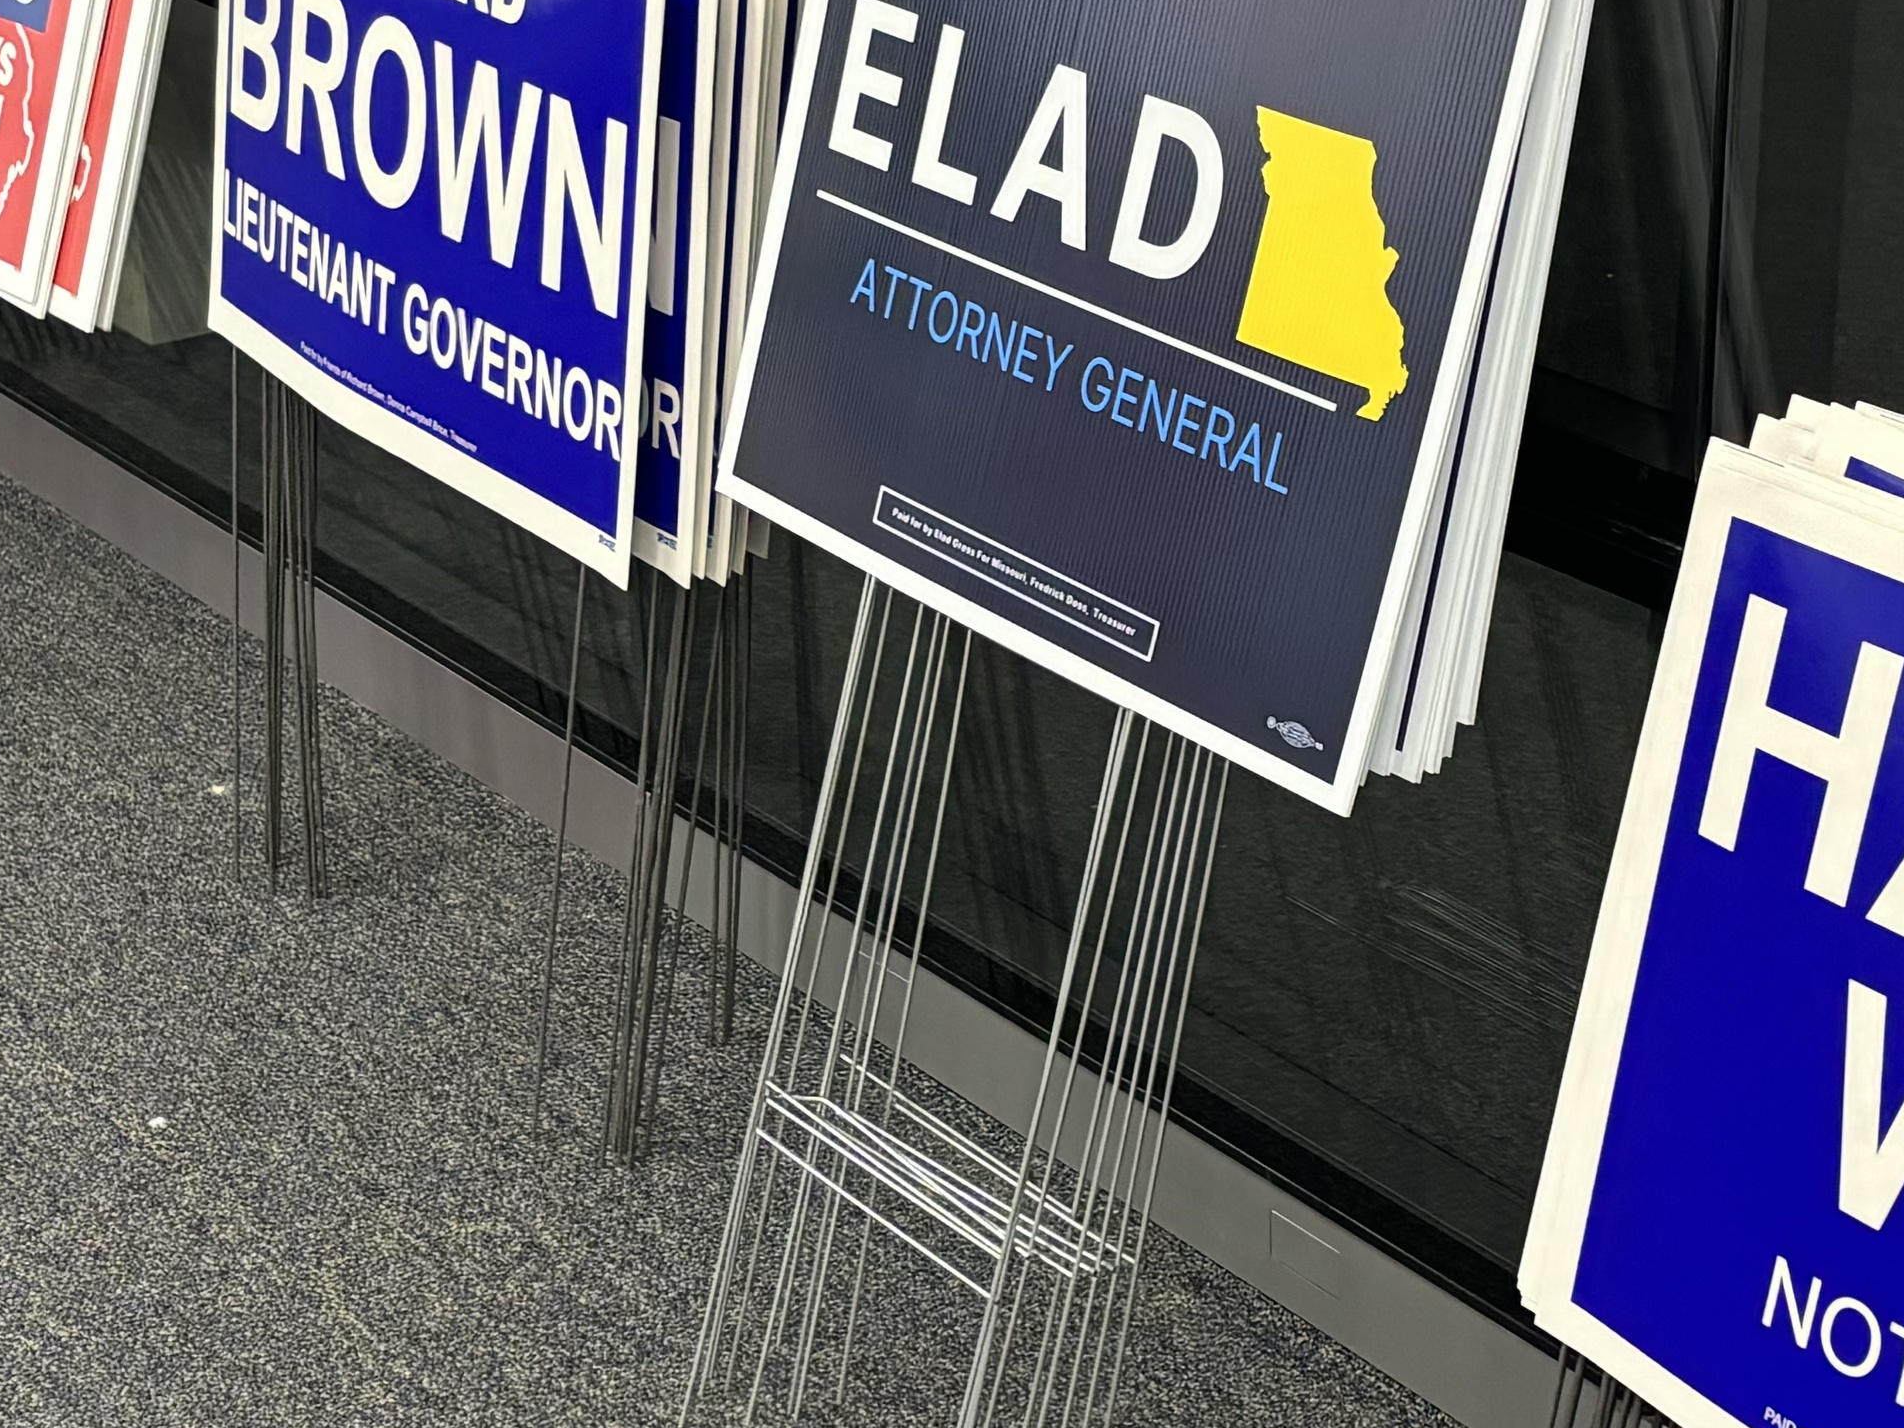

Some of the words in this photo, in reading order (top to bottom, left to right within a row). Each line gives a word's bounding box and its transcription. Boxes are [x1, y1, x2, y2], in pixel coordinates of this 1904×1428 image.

[223, 169, 396, 336] LIEUTENANT
[403, 283, 622, 462] GOVERNOR
[849, 259, 1075, 392] ATTORNEY
[1080, 356, 1289, 494] GENERAL
[892, 507, 910, 523] Paid
[910, 516, 922, 529] for
[922, 522, 933, 537] by
[934, 528, 952, 545] Elad
[952, 538, 975, 557] Gross
[976, 550, 991, 564] For
[1092, 608, 1137, 636] Treasurer
